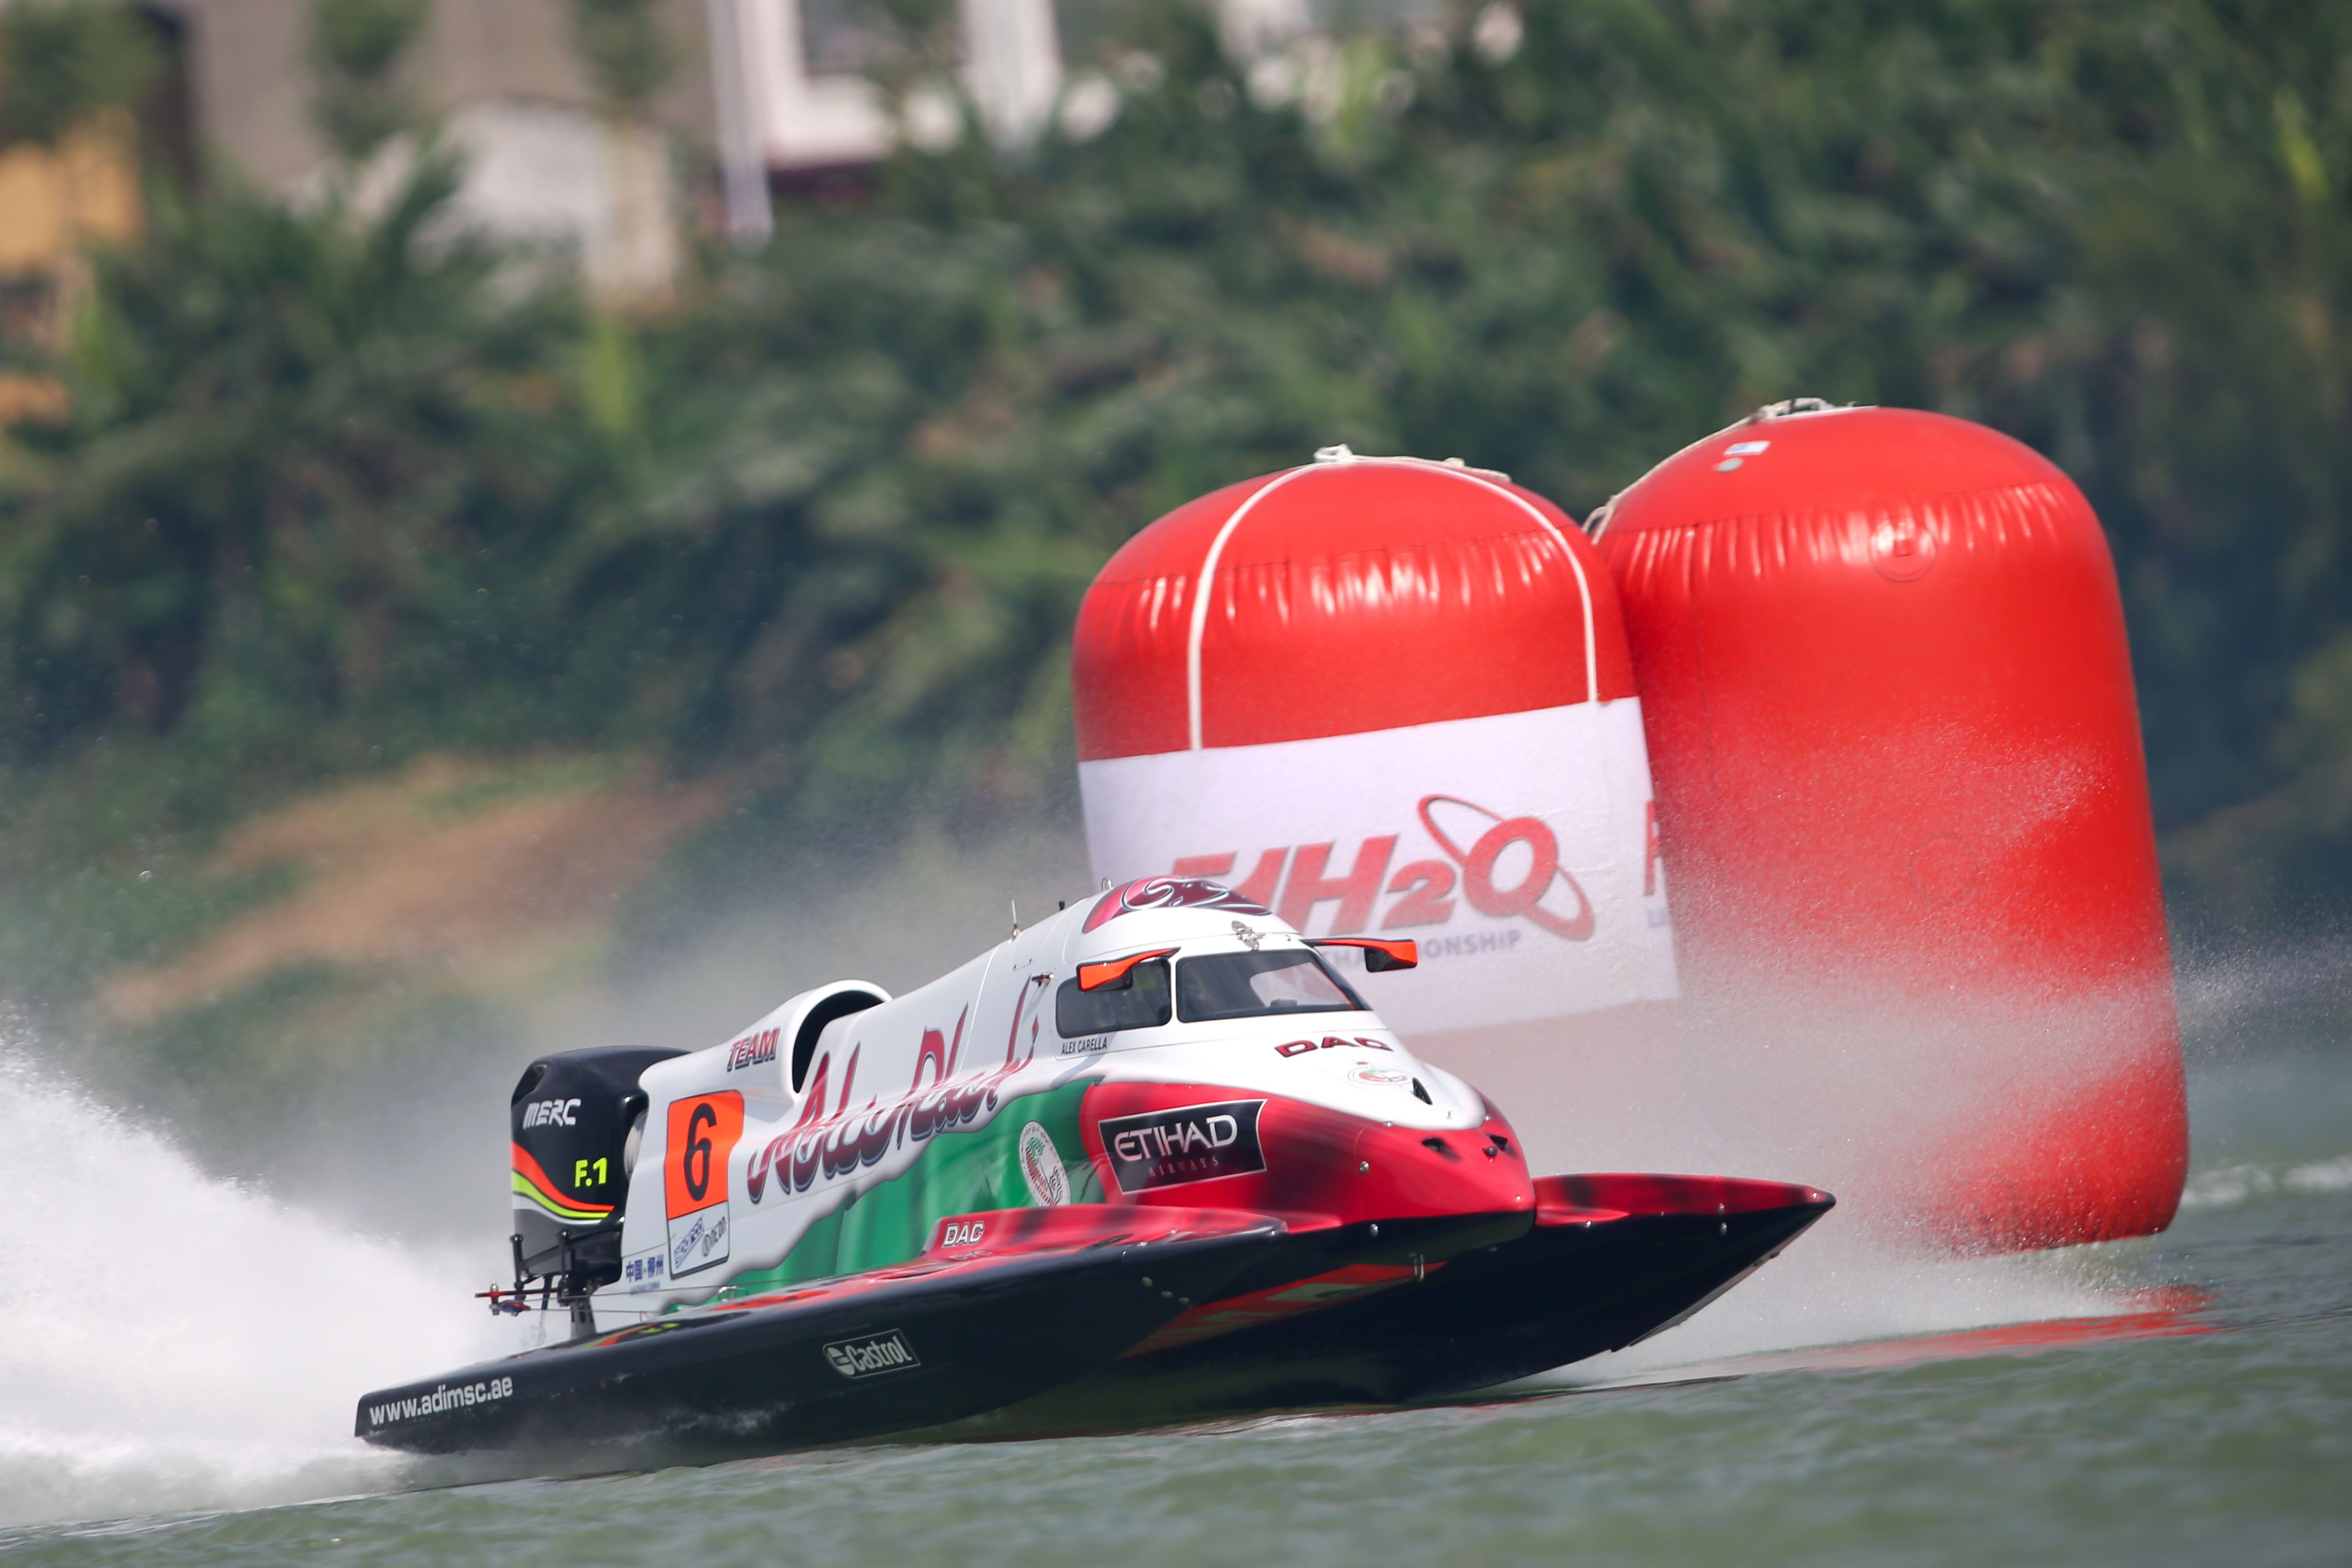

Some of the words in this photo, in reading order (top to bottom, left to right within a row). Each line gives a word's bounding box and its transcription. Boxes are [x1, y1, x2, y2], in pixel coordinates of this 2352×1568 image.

[1322, 929, 1521, 966] HONSHIP
[727, 1027, 780, 1073] TEAM
[1061, 1042, 1077, 1054] ALEX
[1078, 1037, 1107, 1053] CARELLA
[522, 1098, 581, 1130] MERC
[684, 1103, 717, 1201] 6
[1114, 1114, 1238, 1162] ETIHAD
[574, 1157, 608, 1187] F.1
[1148, 1155, 1219, 1177] AIRWAYS
[942, 1220, 985, 1248] DAC
[845, 1335, 913, 1371] Castrol
[369, 1376, 513, 1425] www.adimsc.ae
